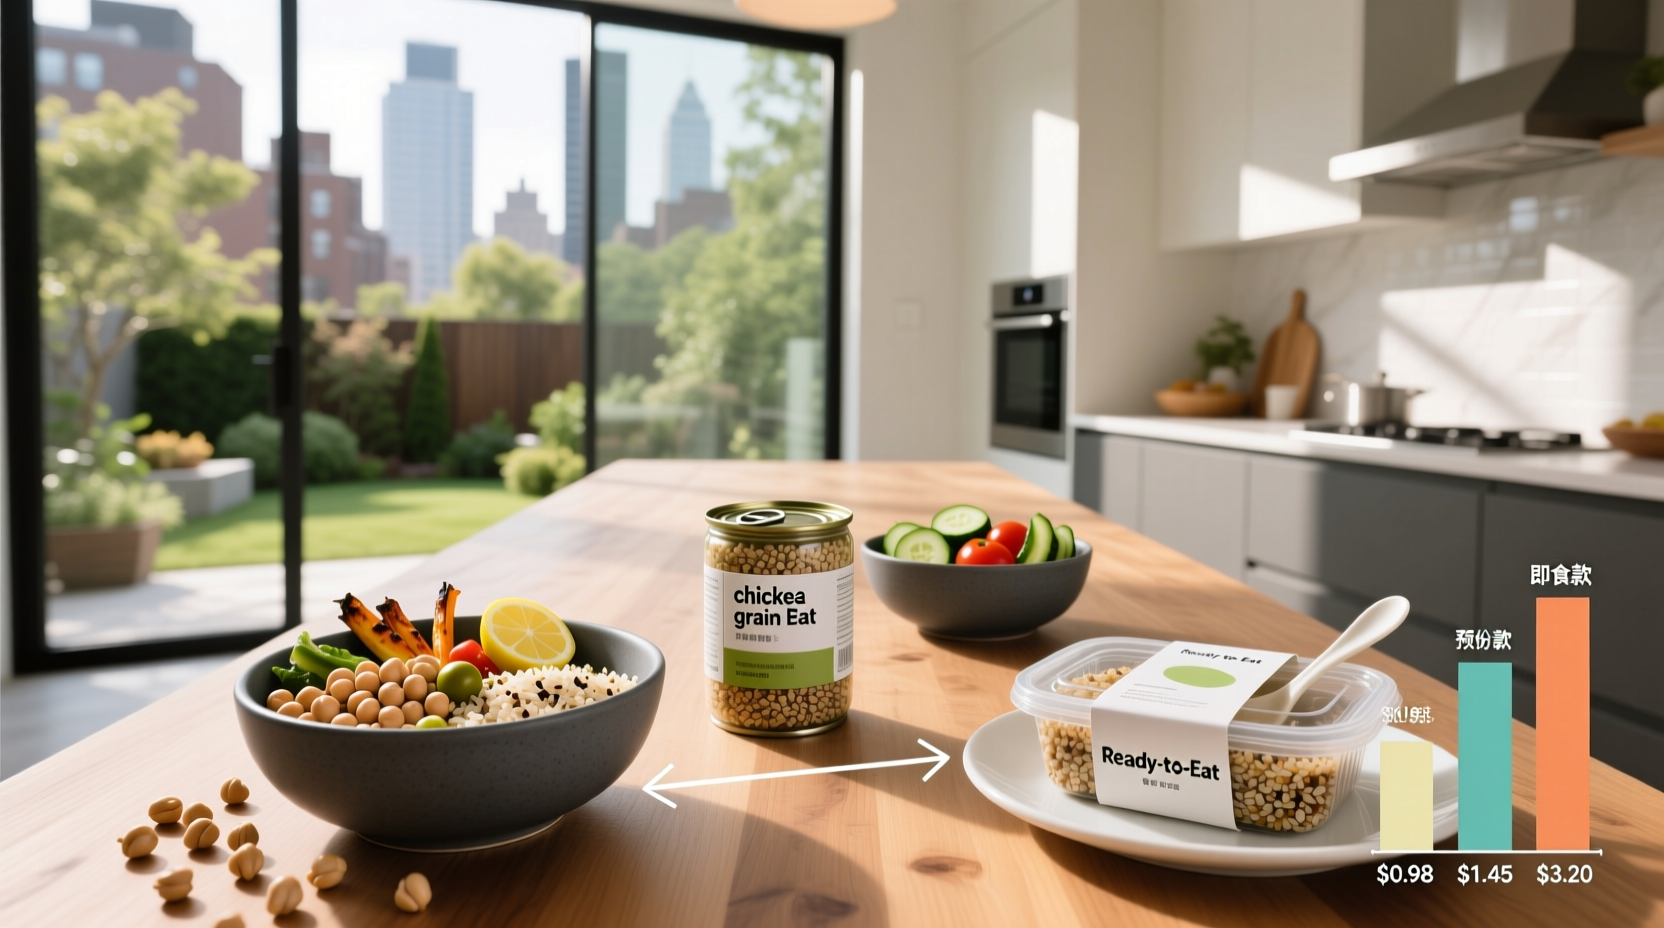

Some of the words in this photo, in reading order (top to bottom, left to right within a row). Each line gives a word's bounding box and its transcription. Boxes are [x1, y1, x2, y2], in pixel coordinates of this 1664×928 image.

[733, 585, 806, 605] chickea
[734, 608, 781, 629] grain
[787, 608, 817, 626] Eat
[1101, 746, 1220, 781] Ready-to-Eat
